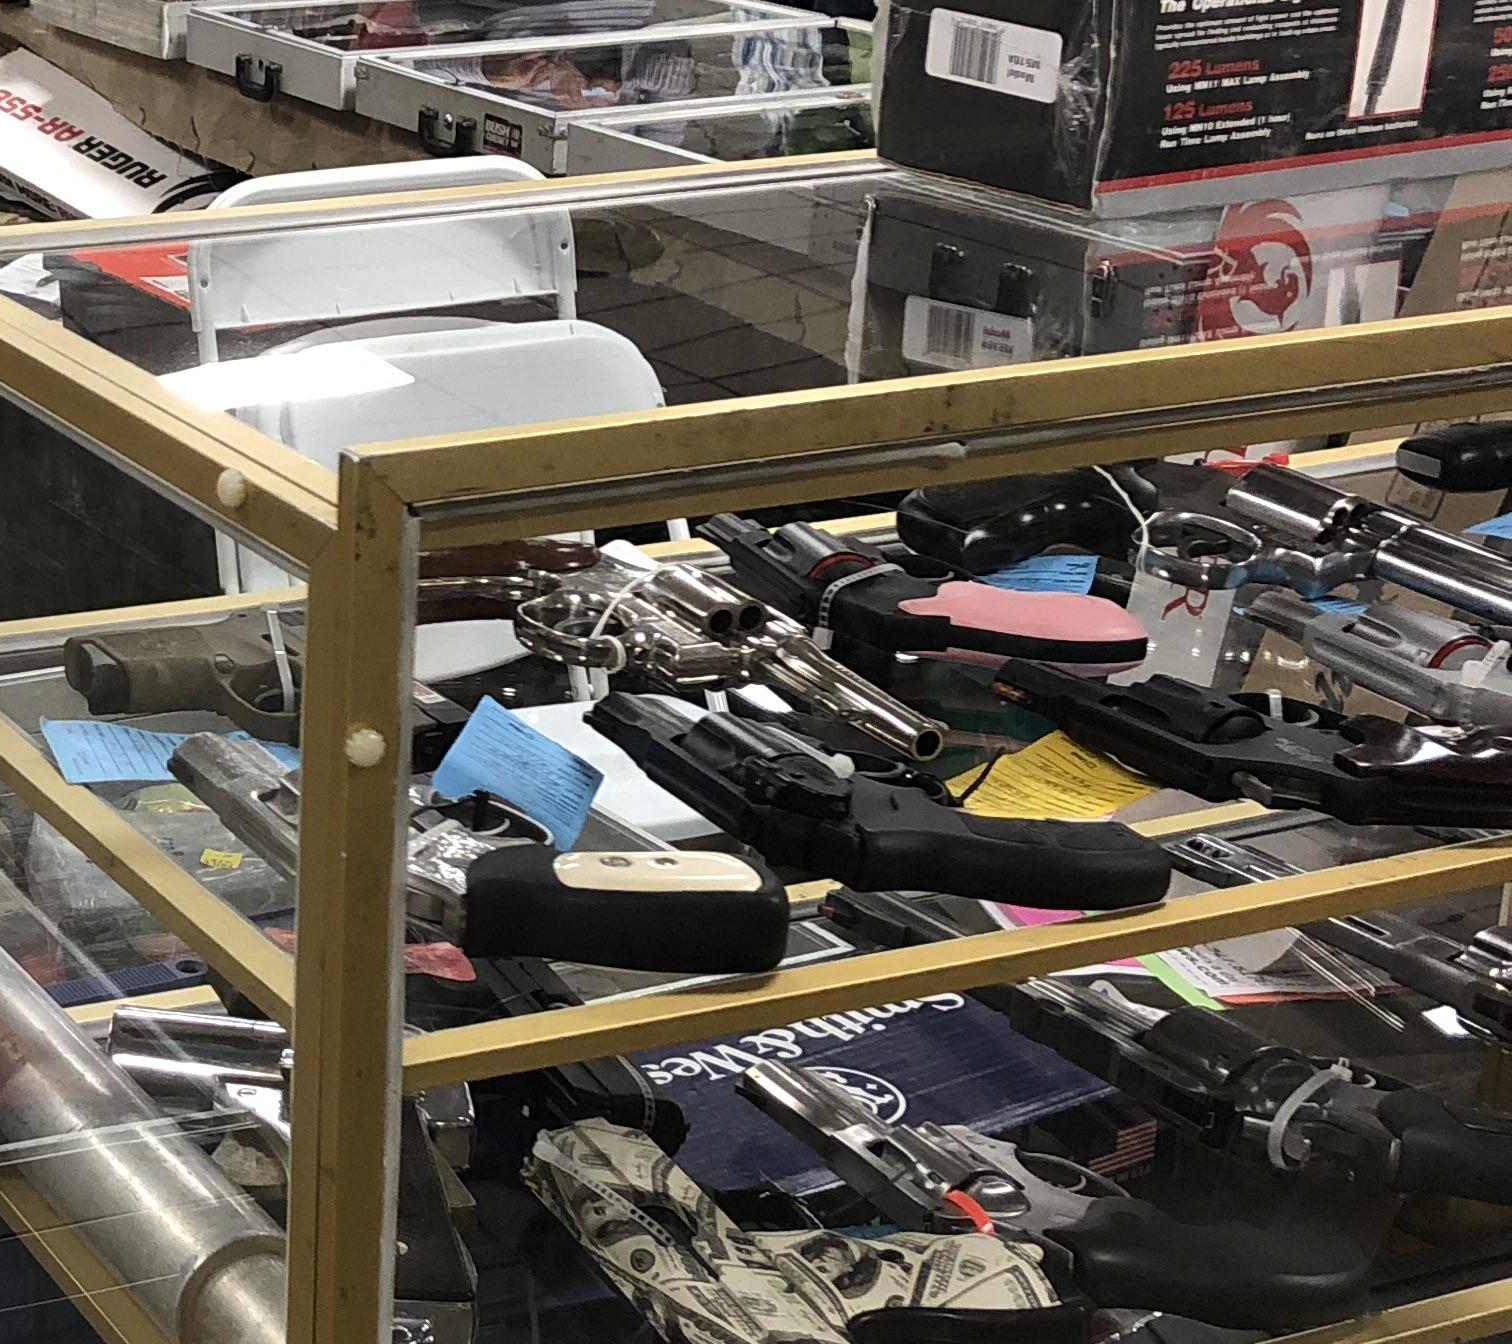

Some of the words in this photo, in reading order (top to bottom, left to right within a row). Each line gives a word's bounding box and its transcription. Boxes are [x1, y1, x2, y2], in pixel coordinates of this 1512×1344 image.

[1168, 59, 1203, 81] 225
[1206, 58, 1261, 76] Lumens
[1163, 101, 1196, 122] 125
[1199, 100, 1254, 118] Lumens
[72, 135, 168, 189] RUGER
